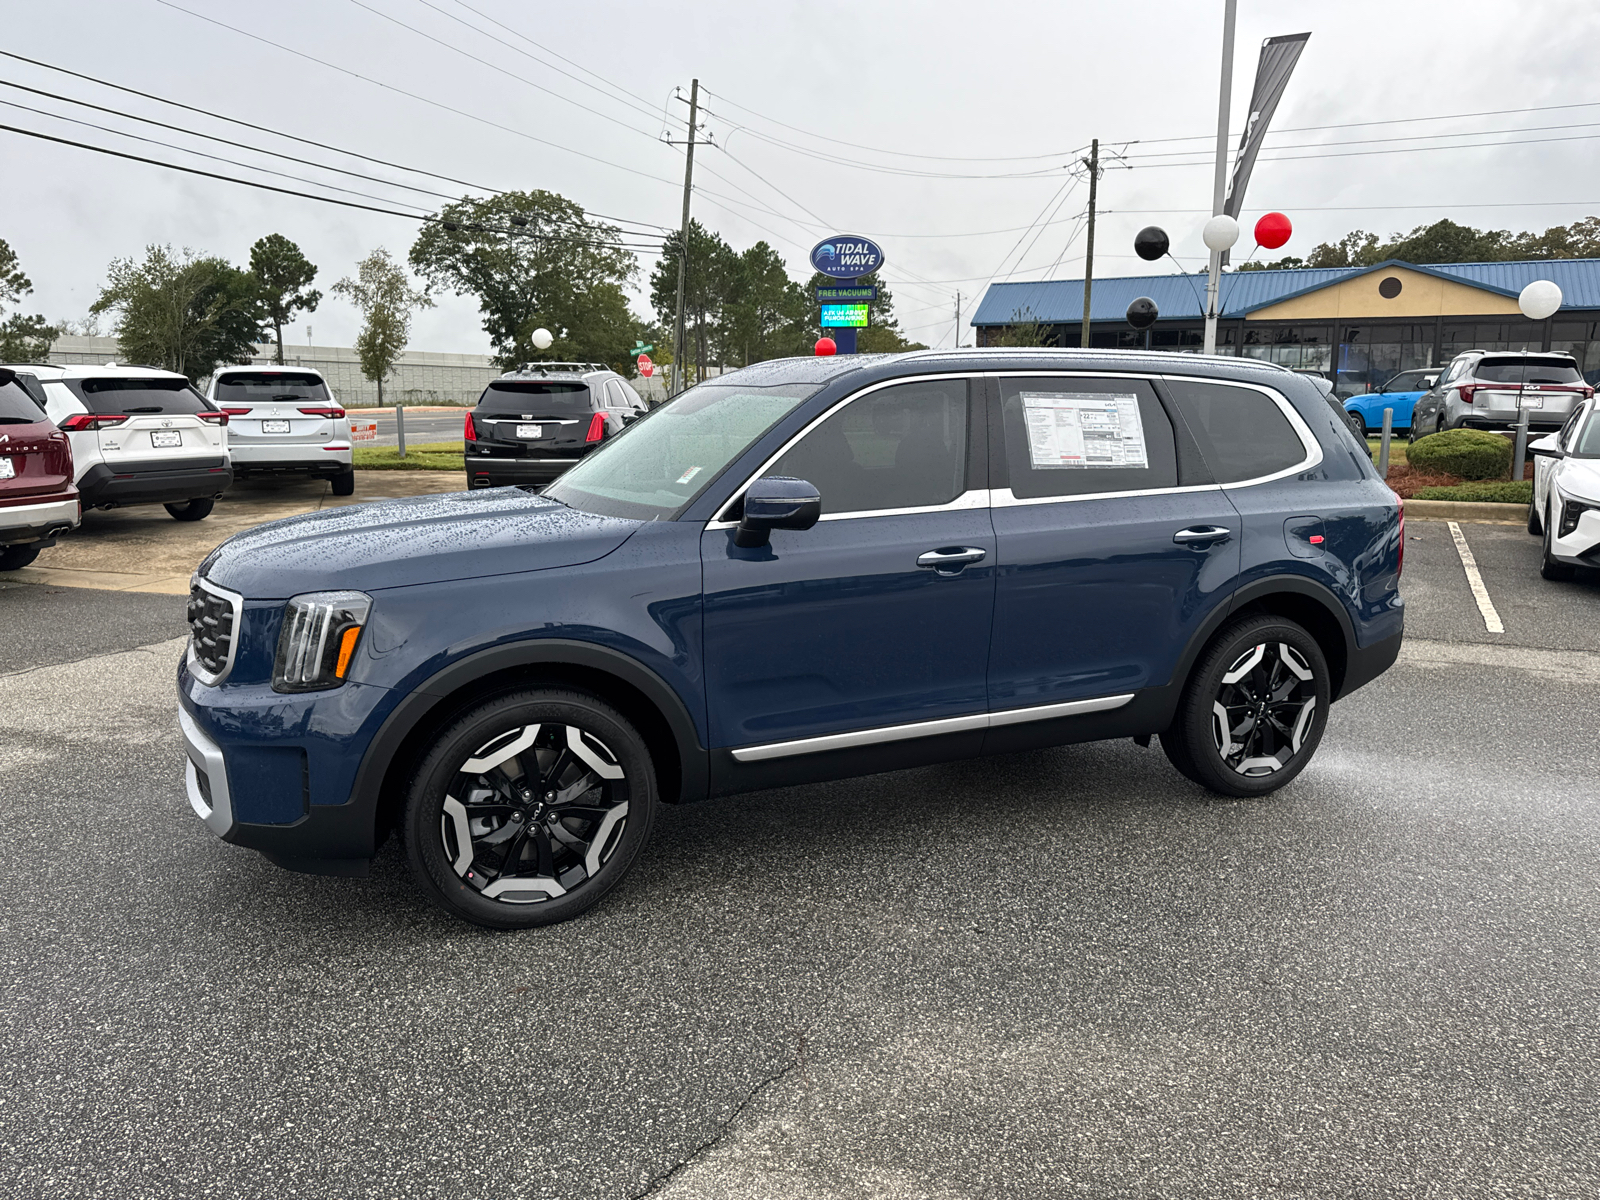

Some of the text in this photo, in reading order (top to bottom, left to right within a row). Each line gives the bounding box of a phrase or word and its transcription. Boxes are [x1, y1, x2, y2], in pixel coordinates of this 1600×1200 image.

[835, 243, 869, 254] TIDAL
[840, 254, 876, 265] WAVE
[818, 288, 873, 297] FREE VACUUMS
[638, 362, 652, 371] STOP
